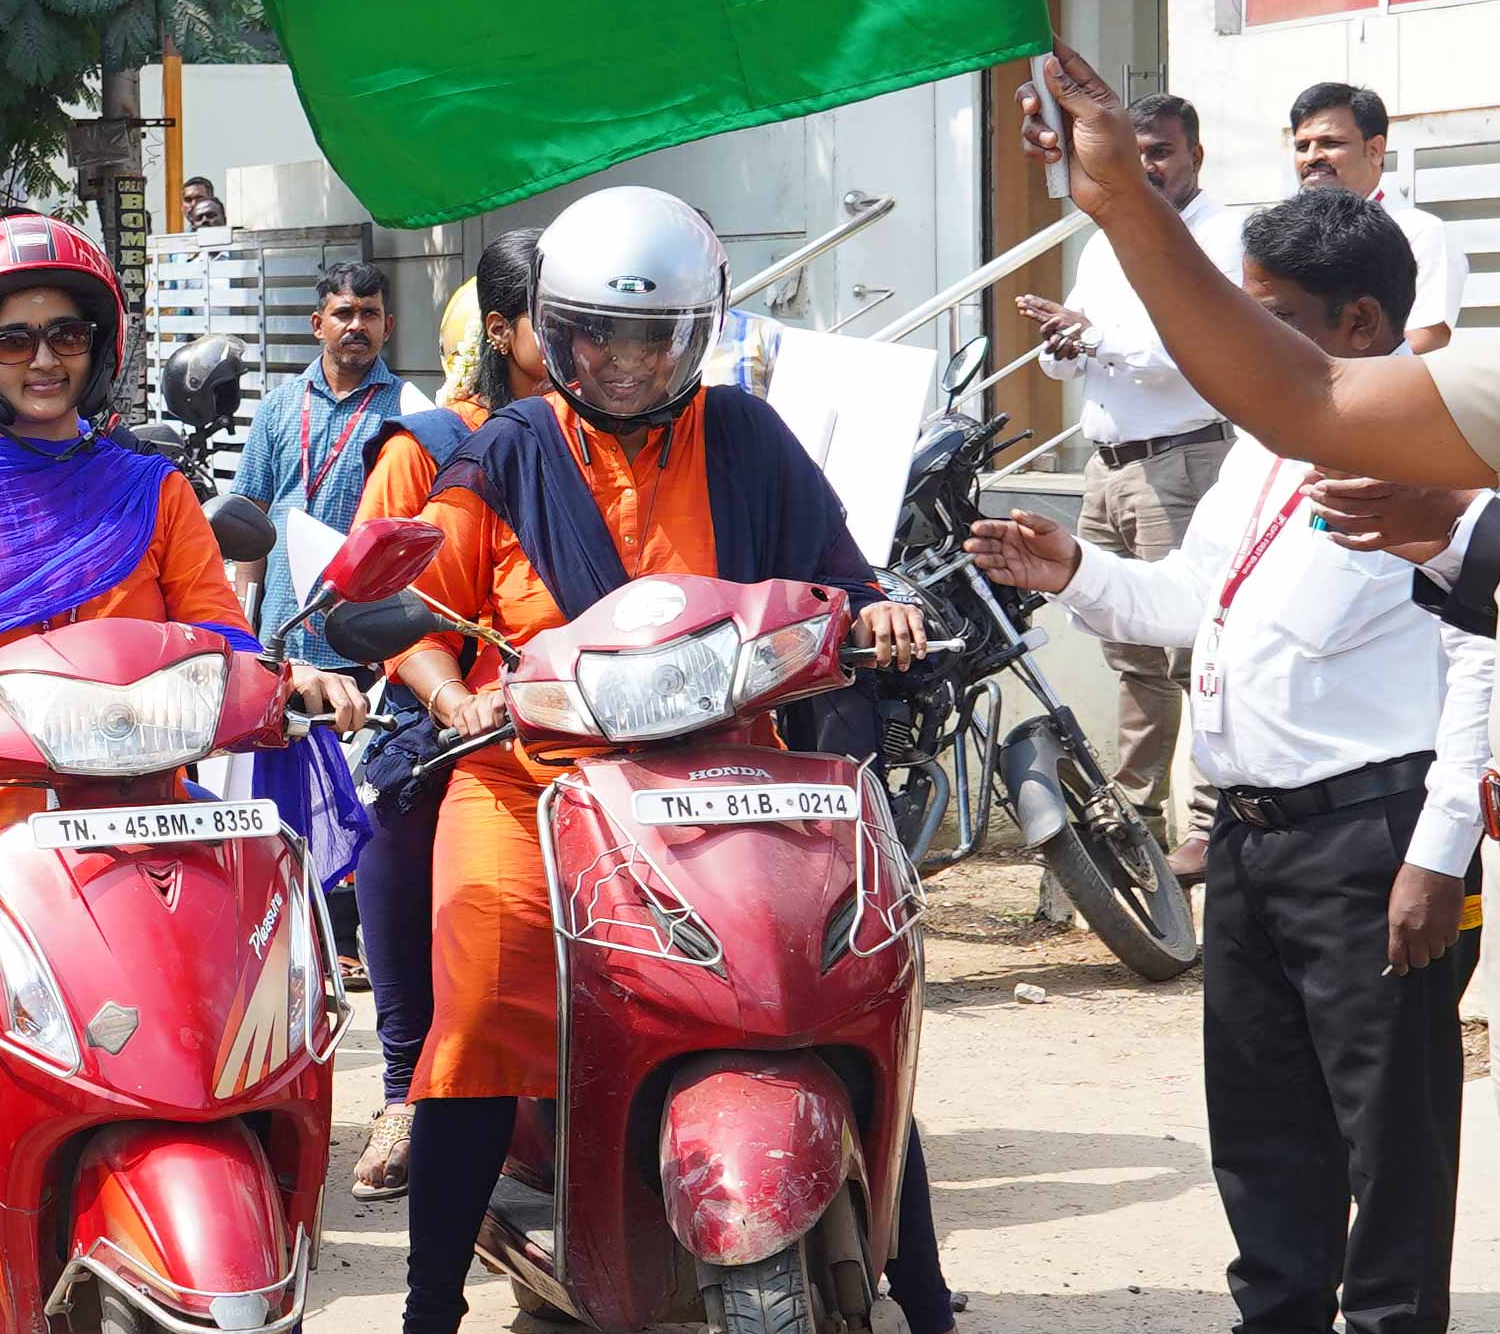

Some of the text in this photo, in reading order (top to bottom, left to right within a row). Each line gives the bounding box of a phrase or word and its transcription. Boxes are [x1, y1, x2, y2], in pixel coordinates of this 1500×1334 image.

[688, 766, 773, 781] HONDA
[661, 795, 700, 818] TN.
[798, 791, 848, 815] 0214
[59, 818, 97, 842] TN.
[212, 808, 264, 833] 8356
[248, 892, 284, 961] Pleasure
